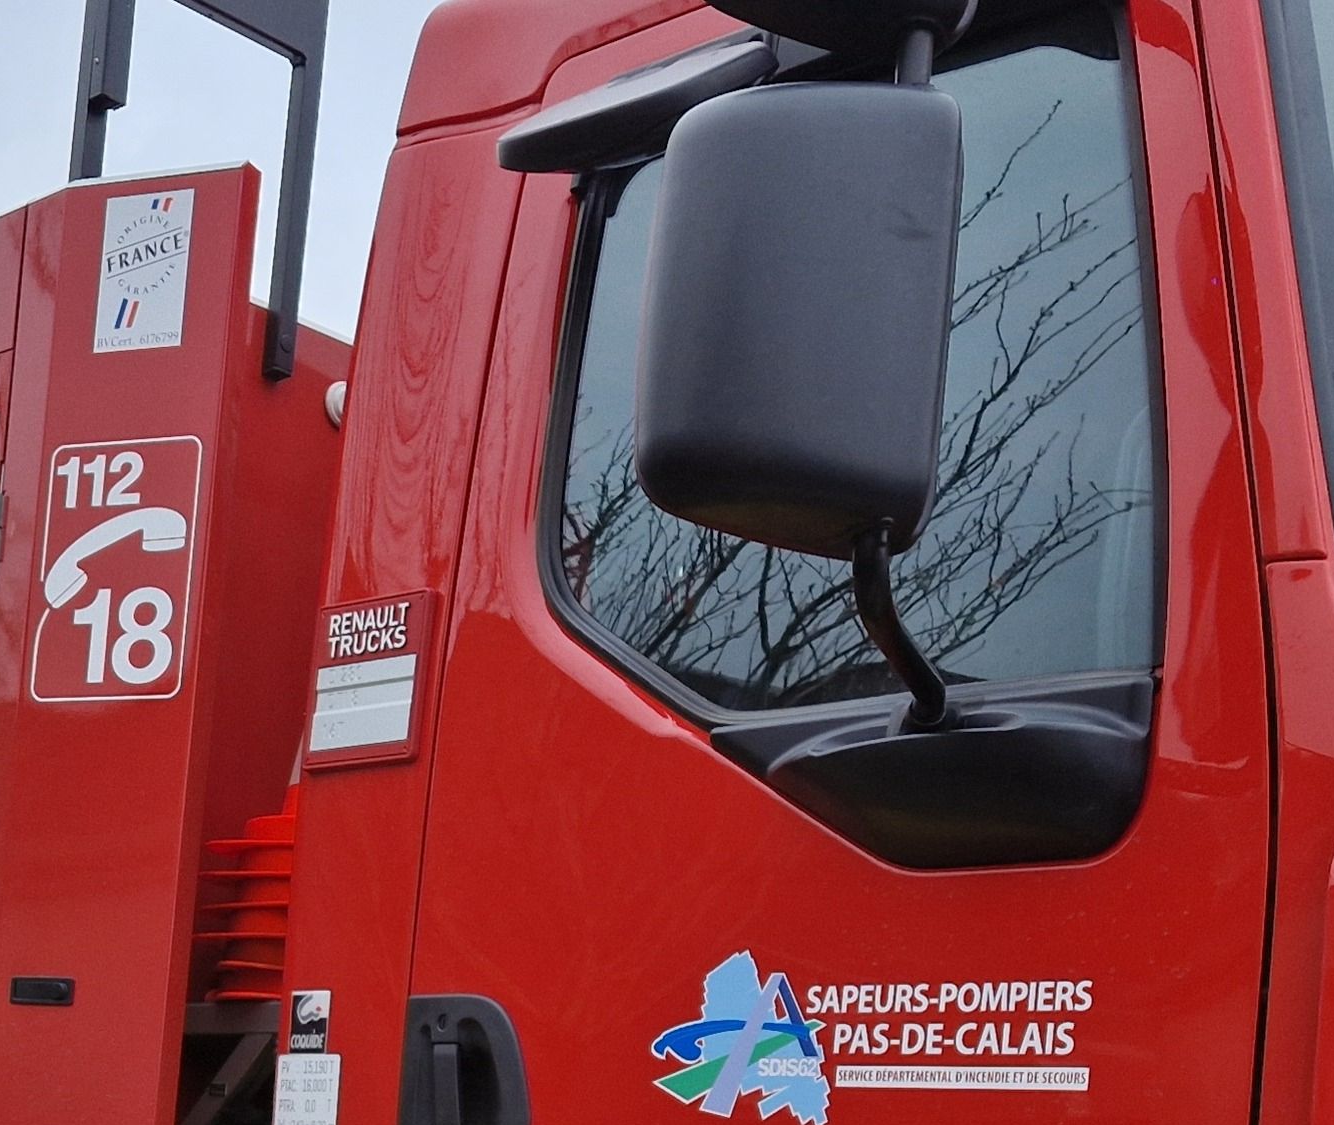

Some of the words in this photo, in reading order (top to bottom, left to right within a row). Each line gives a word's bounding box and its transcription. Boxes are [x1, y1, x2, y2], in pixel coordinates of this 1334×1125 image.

[117, 214, 169, 244] ORIGINE
[106, 231, 183, 273] FRANCE
[57, 451, 144, 508] 112
[73, 586, 173, 684] 18
[329, 602, 410, 637] RENAULT
[328, 626, 407, 658] TRUCKS
[806, 980, 1093, 1014] SAPEURS-POMPIERS
[833, 1022, 1075, 1055] PAS-DE-CALAIS
[758, 1058, 818, 1077] SDIS62
[838, 1069, 873, 1082] SERVICE
[875, 1067, 952, 1083] DÉPARTEMENTAL
[956, 1070, 1011, 1084] D'INCENDIE
[1013, 1071, 1024, 1083] ET
[1027, 1071, 1040, 1084] DE
[1042, 1072, 1087, 1084] SECOURS
